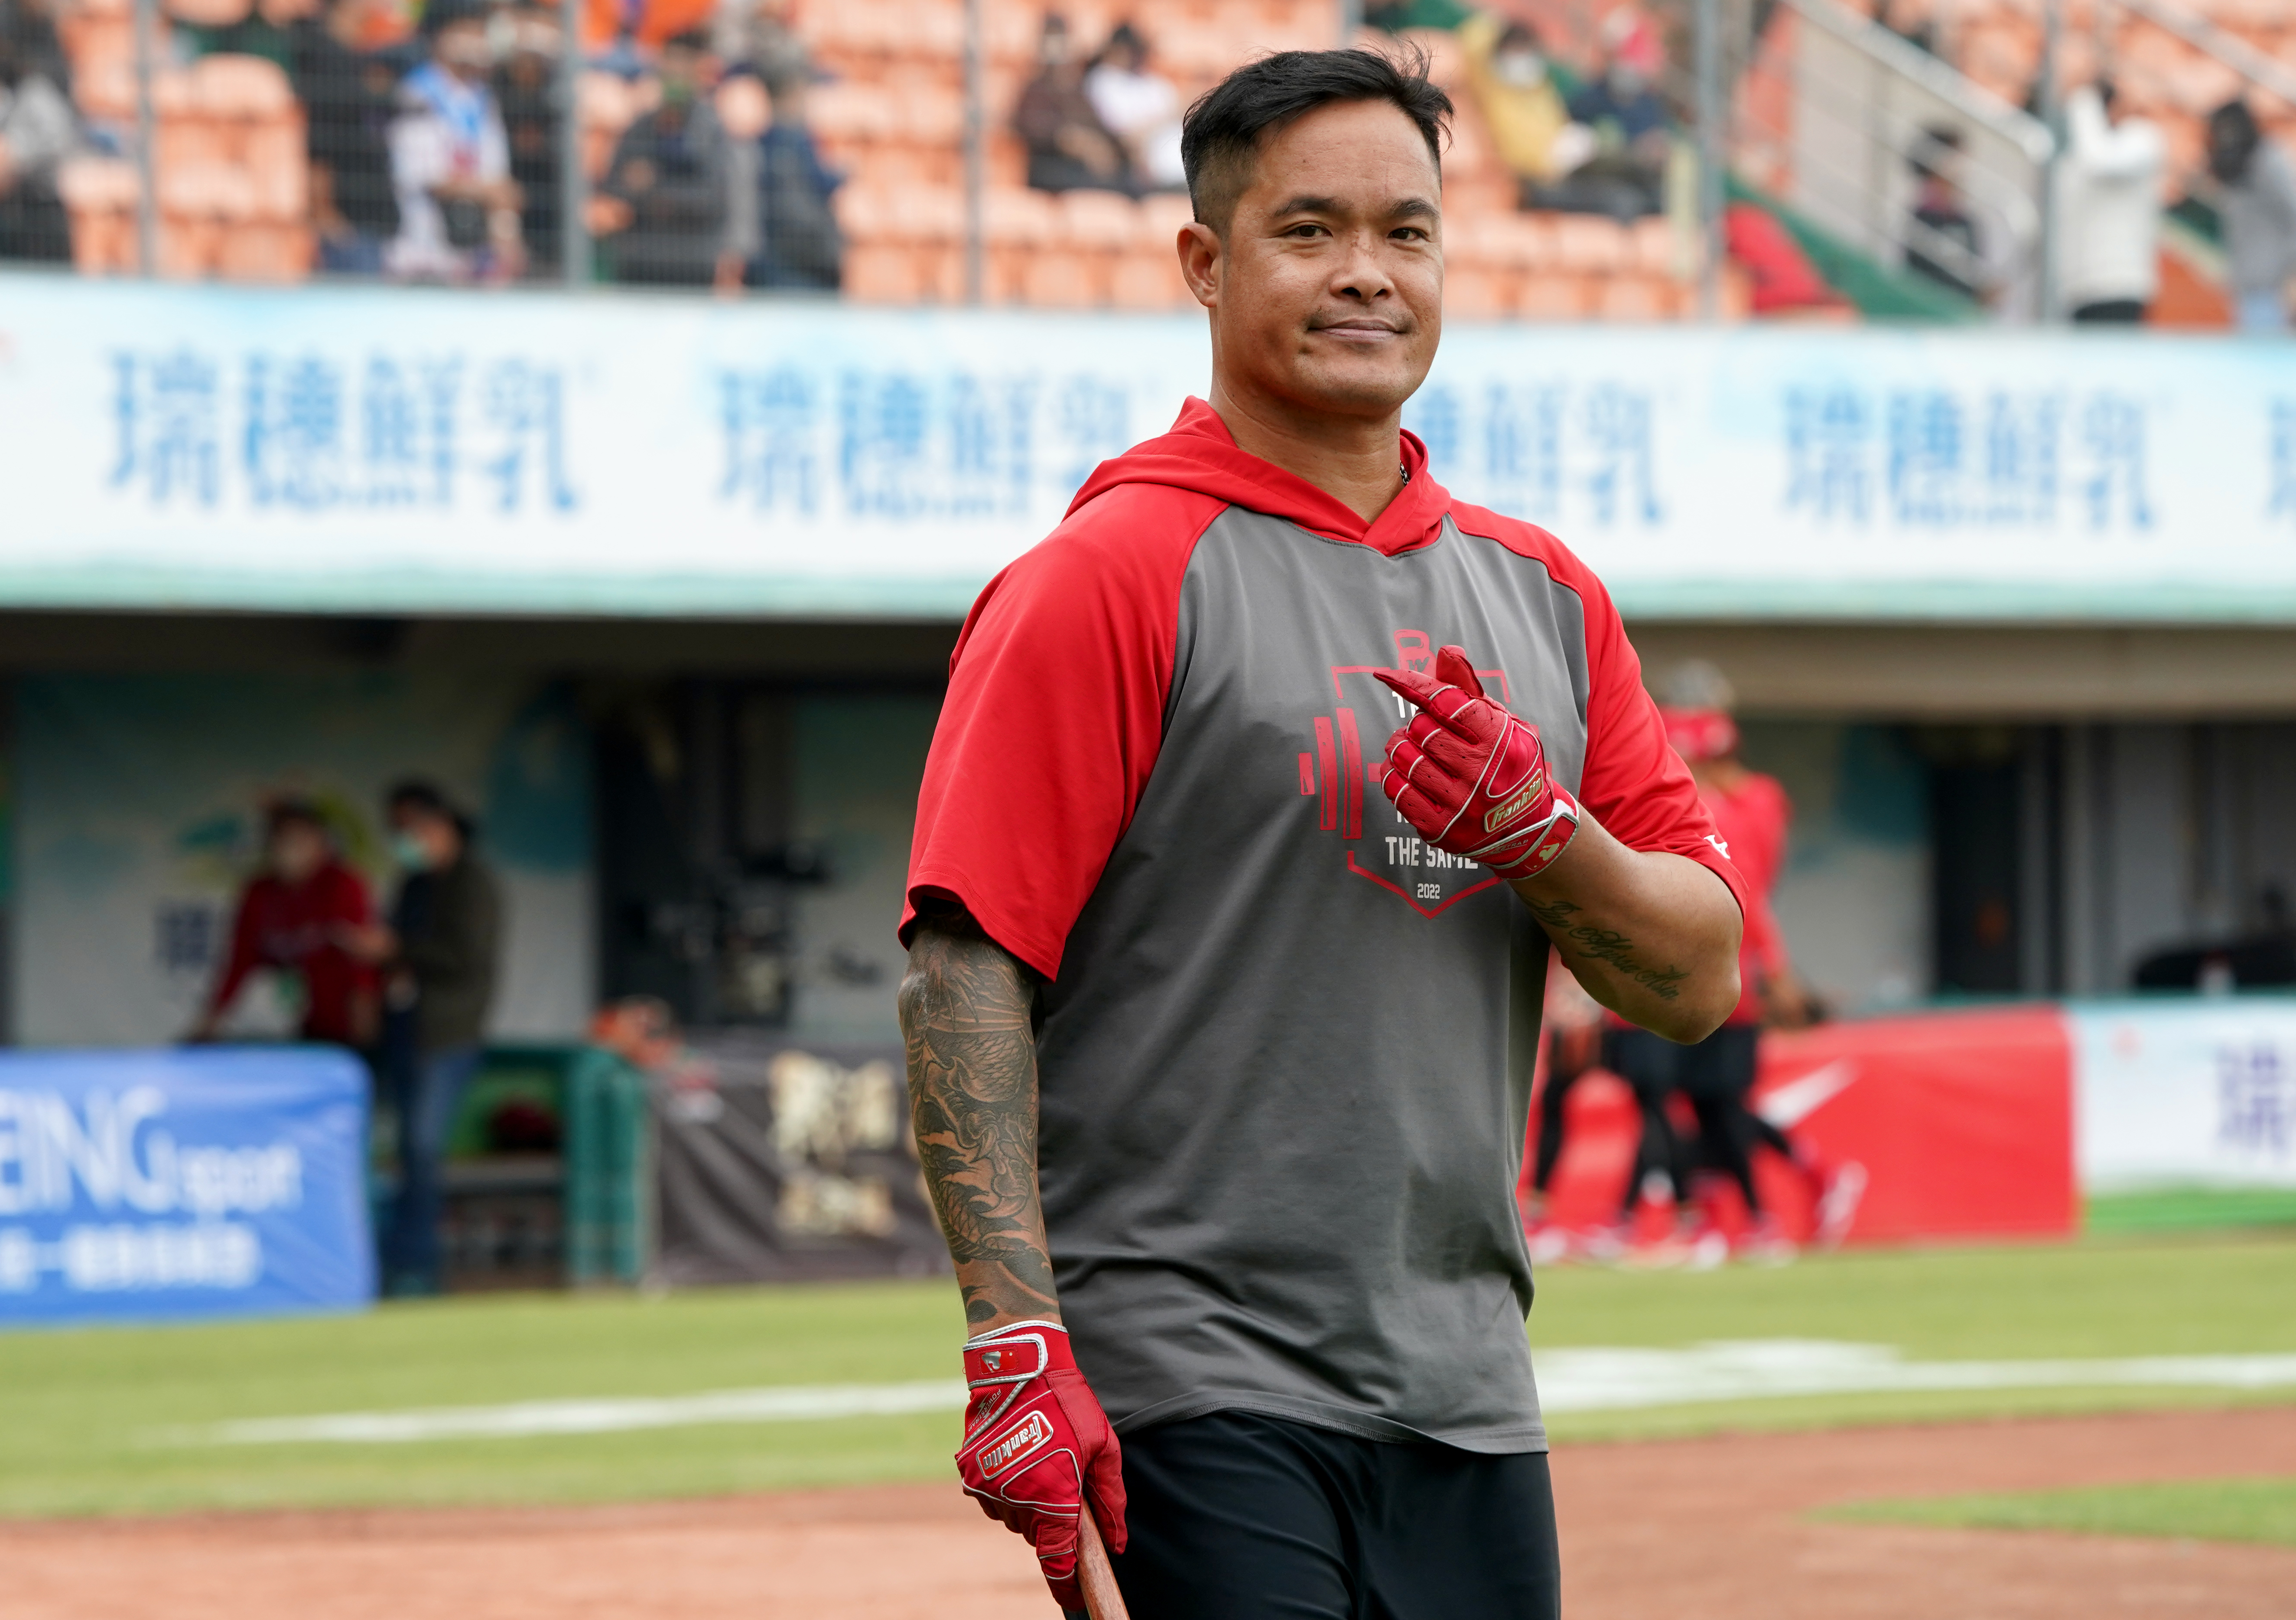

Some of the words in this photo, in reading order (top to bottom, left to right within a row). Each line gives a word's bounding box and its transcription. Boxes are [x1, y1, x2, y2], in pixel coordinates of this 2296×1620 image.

[1385, 836, 1420, 866] THE
[1417, 883, 1440, 899] 2022
[969, 1388, 1002, 1431] POWERSTRAP
[983, 1415, 1042, 1470] Franklin
